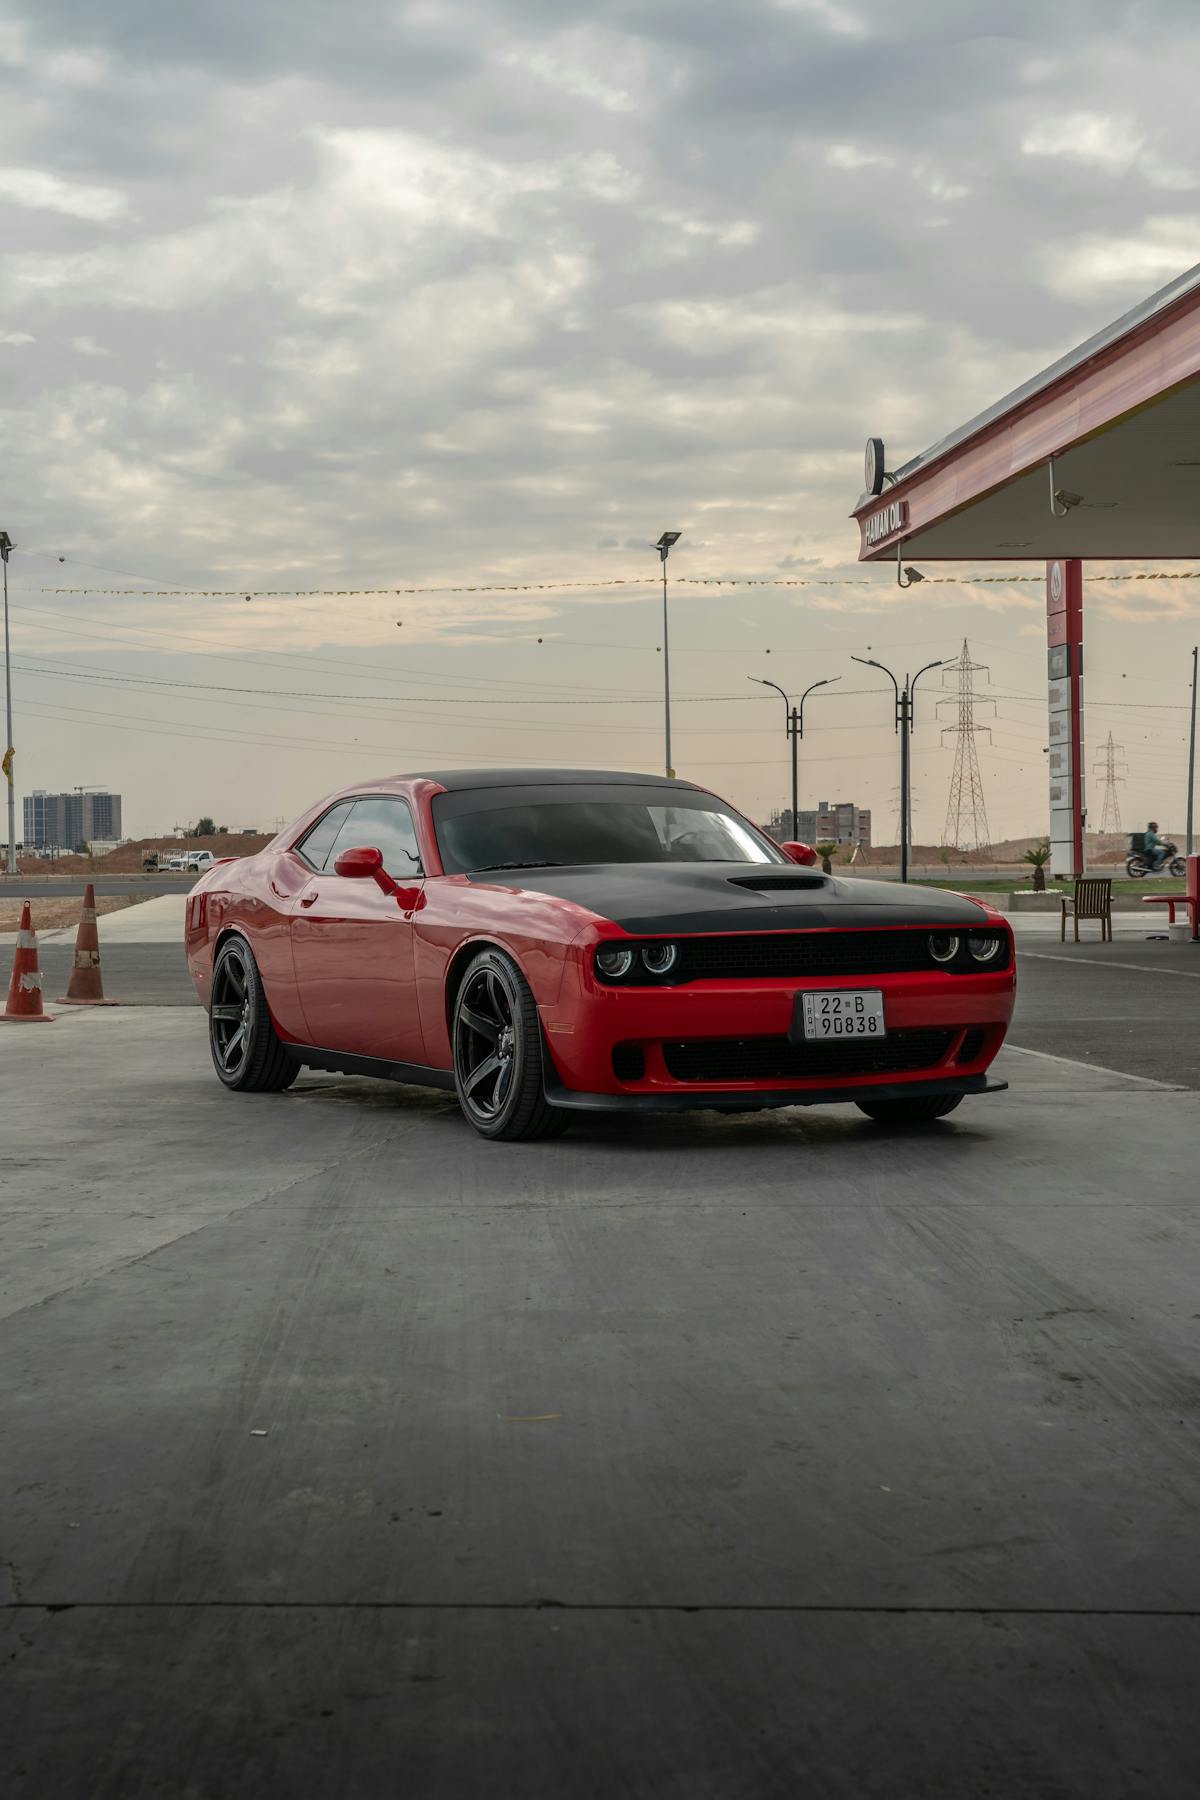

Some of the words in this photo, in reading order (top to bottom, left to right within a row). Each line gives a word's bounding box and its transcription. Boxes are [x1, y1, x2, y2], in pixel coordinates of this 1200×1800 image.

[890, 502, 902, 531] OIL
[821, 997, 842, 1014] 22
[855, 996, 865, 1013] B
[822, 1016, 877, 1035] 90838
